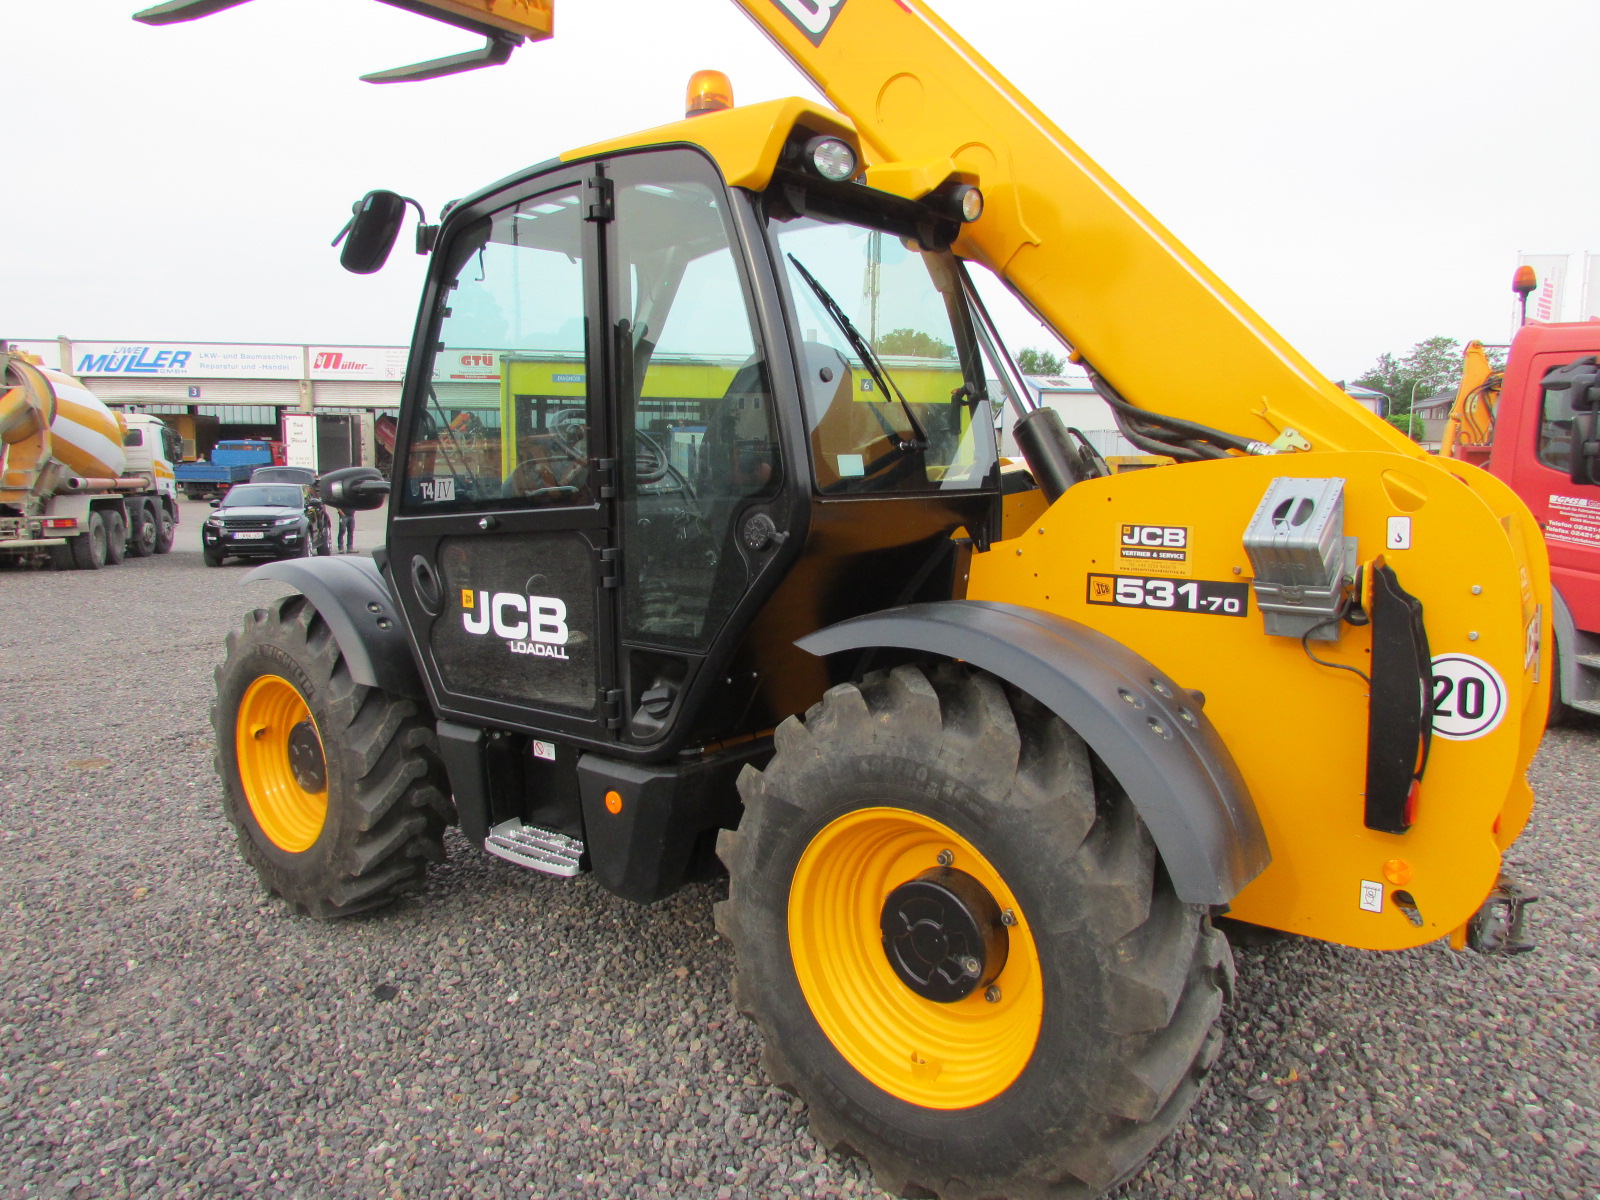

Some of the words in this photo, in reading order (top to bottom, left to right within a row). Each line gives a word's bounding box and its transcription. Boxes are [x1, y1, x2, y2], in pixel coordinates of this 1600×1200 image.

[113, 346, 142, 354] UWE
[77, 346, 193, 373] MÜLLER
[199, 362, 239, 371] Reparatur
[313, 352, 368, 370] Müller
[460, 353, 493, 367] GTÜ
[191, 387, 198, 396] 3
[862, 380, 870, 391] 6
[420, 482, 435, 500] T4
[436, 480, 452, 499] IV
[1557, 496, 1581, 505] GMS
[1545, 526, 1569, 535] Telefax
[1548, 519, 1573, 529] Telefon
[1122, 526, 1186, 547] JCB
[1121, 549, 1151, 558] VERTRIEB
[1158, 551, 1185, 560] SERVICE
[1115, 577, 1240, 613] 531-70
[462, 590, 569, 645] JCB
[510, 640, 570, 660] LOADALL
[1432, 674, 1485, 720] 20
